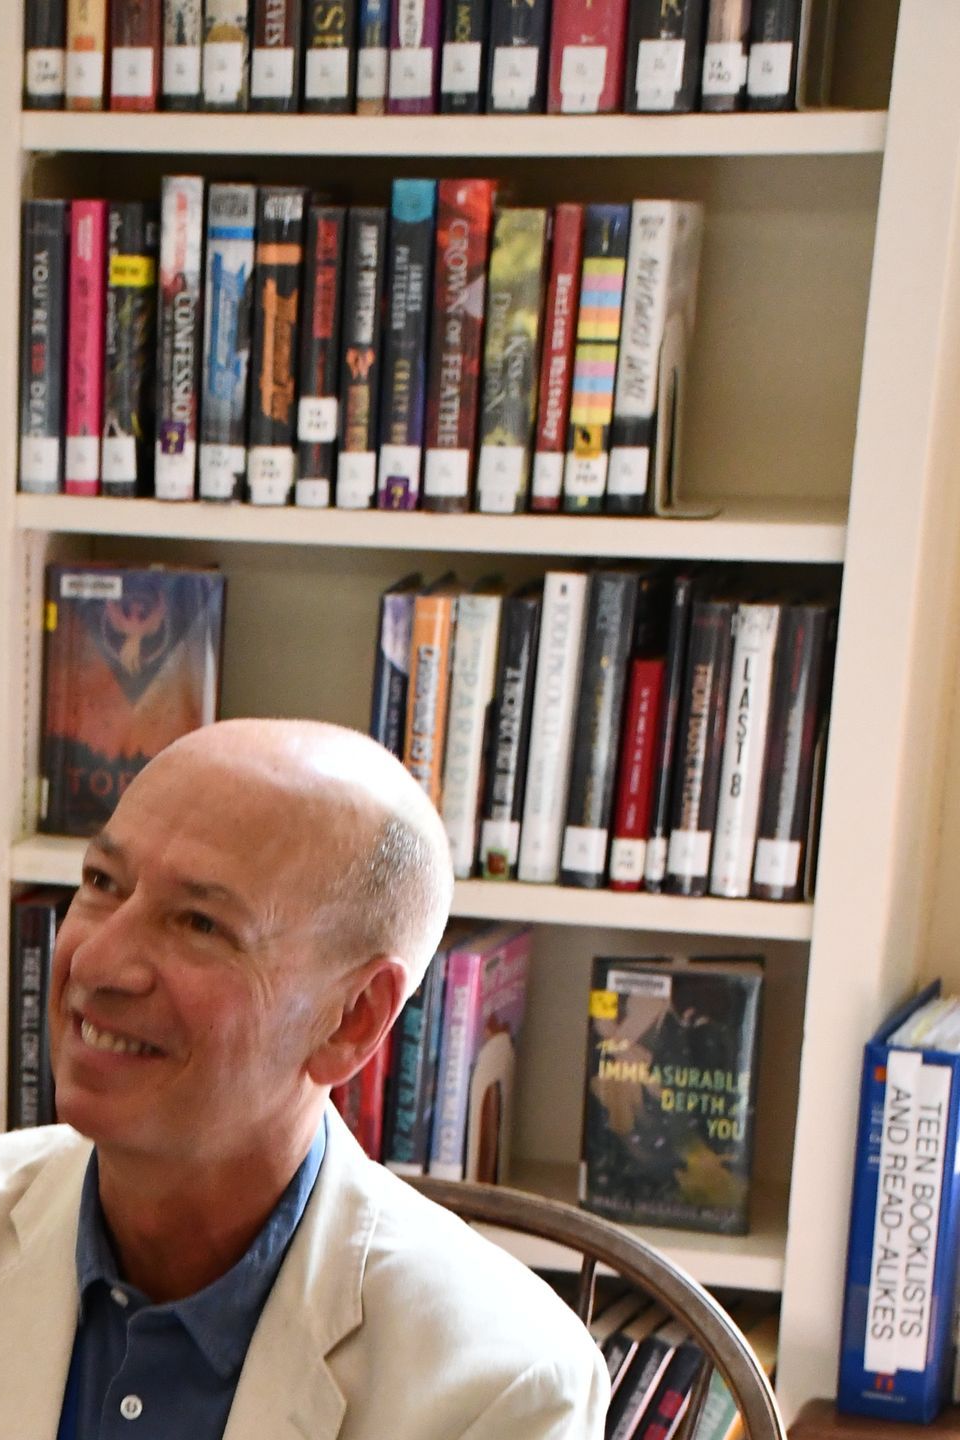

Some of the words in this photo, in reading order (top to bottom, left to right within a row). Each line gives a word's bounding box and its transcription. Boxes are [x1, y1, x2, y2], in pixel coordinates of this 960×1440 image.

[31, 249, 50, 335] YOU'RE
[391, 245, 412, 330] PATTERSON
[407, 263, 424, 312] JAMES
[444, 218, 471, 314] CROWN
[437, 353, 463, 449] FEATHE
[733, 656, 753, 766] LAST
[730, 773, 741, 799] 8
[661, 1089, 726, 1116] DEPTH
[707, 1119, 745, 1142] YOU
[886, 1084, 912, 1145] AND
[915, 1102, 942, 1174] TEEN
[871, 1152, 908, 1340] READ-ALIKES
[899, 1184, 935, 1339] BOOKLISTS
